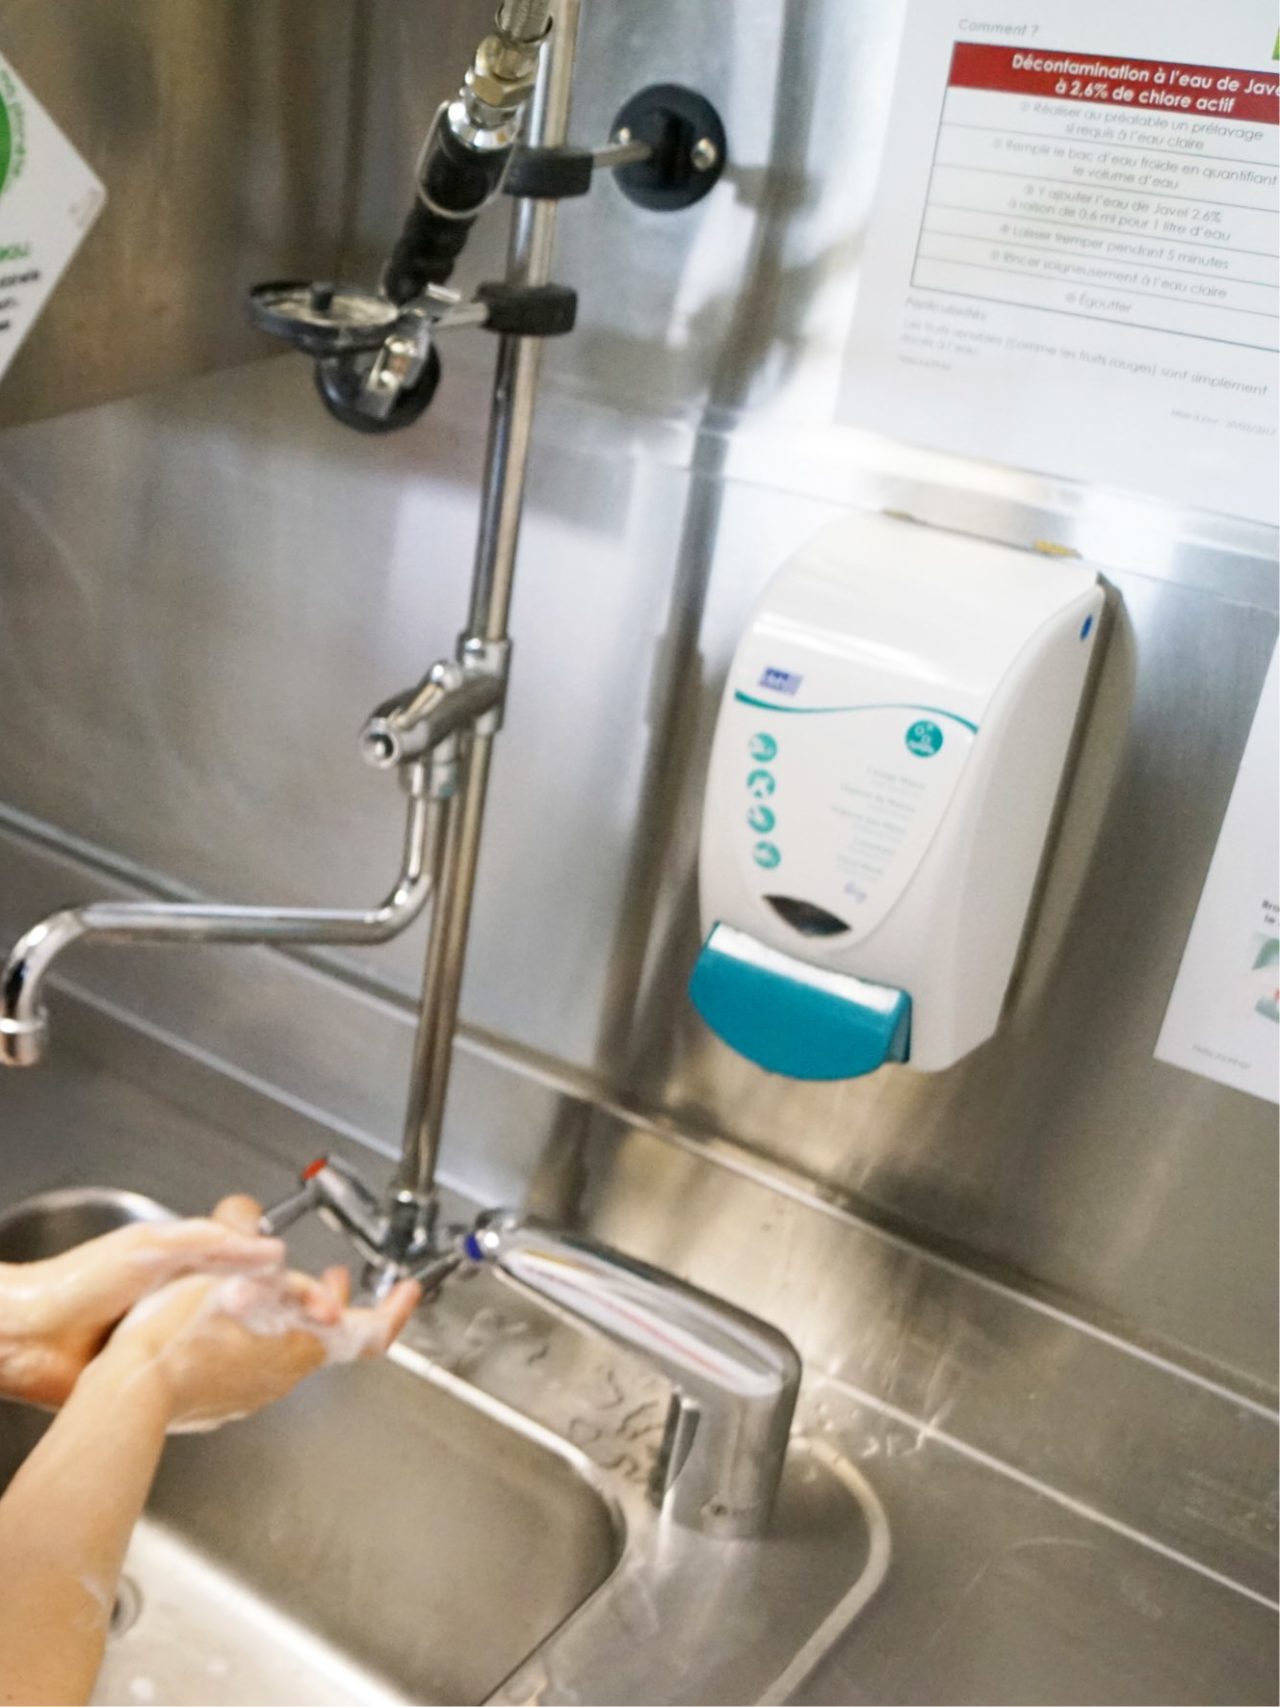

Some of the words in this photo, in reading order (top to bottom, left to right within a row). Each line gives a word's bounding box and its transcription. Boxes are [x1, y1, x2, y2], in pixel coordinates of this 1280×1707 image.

[958, 18, 1027, 35] Comment
[1030, 24, 1040, 37] ?
[1011, 53, 1150, 83] Décontamination
[1153, 66, 1166, 84] à
[1169, 70, 1213, 89] l'eau
[1216, 76, 1240, 92] de
[1055, 76, 1067, 94] à
[1070, 80, 1108, 99] 2,6%
[1111, 86, 1135, 102] de
[1138, 89, 1192, 108] chlore
[1196, 97, 1236, 113] actif
[1084, 110, 1101, 121] au
[1104, 111, 1168, 129] préalable
[1171, 119, 1189, 131] un
[1191, 121, 1264, 142] prélavage
[1129, 129, 1165, 146] l'eau
[1167, 134, 1204, 150] claire
[1068, 148, 1093, 161] bac
[1097, 152, 1137, 167] d'eau
[1140, 157, 1179, 173] froide
[1182, 164, 1199, 176] en
[1202, 167, 1278, 186] quantifiant
[1088, 168, 1135, 183] volume
[1138, 174, 1179, 190] d'eau
[1131, 200, 1150, 213] de
[1153, 203, 1189, 218] Javel
[1118, 215, 1149, 229] pour
[1189, 226, 1232, 241] d'eau
[1177, 253, 1229, 270] minutes
[1189, 283, 1228, 299] claire
